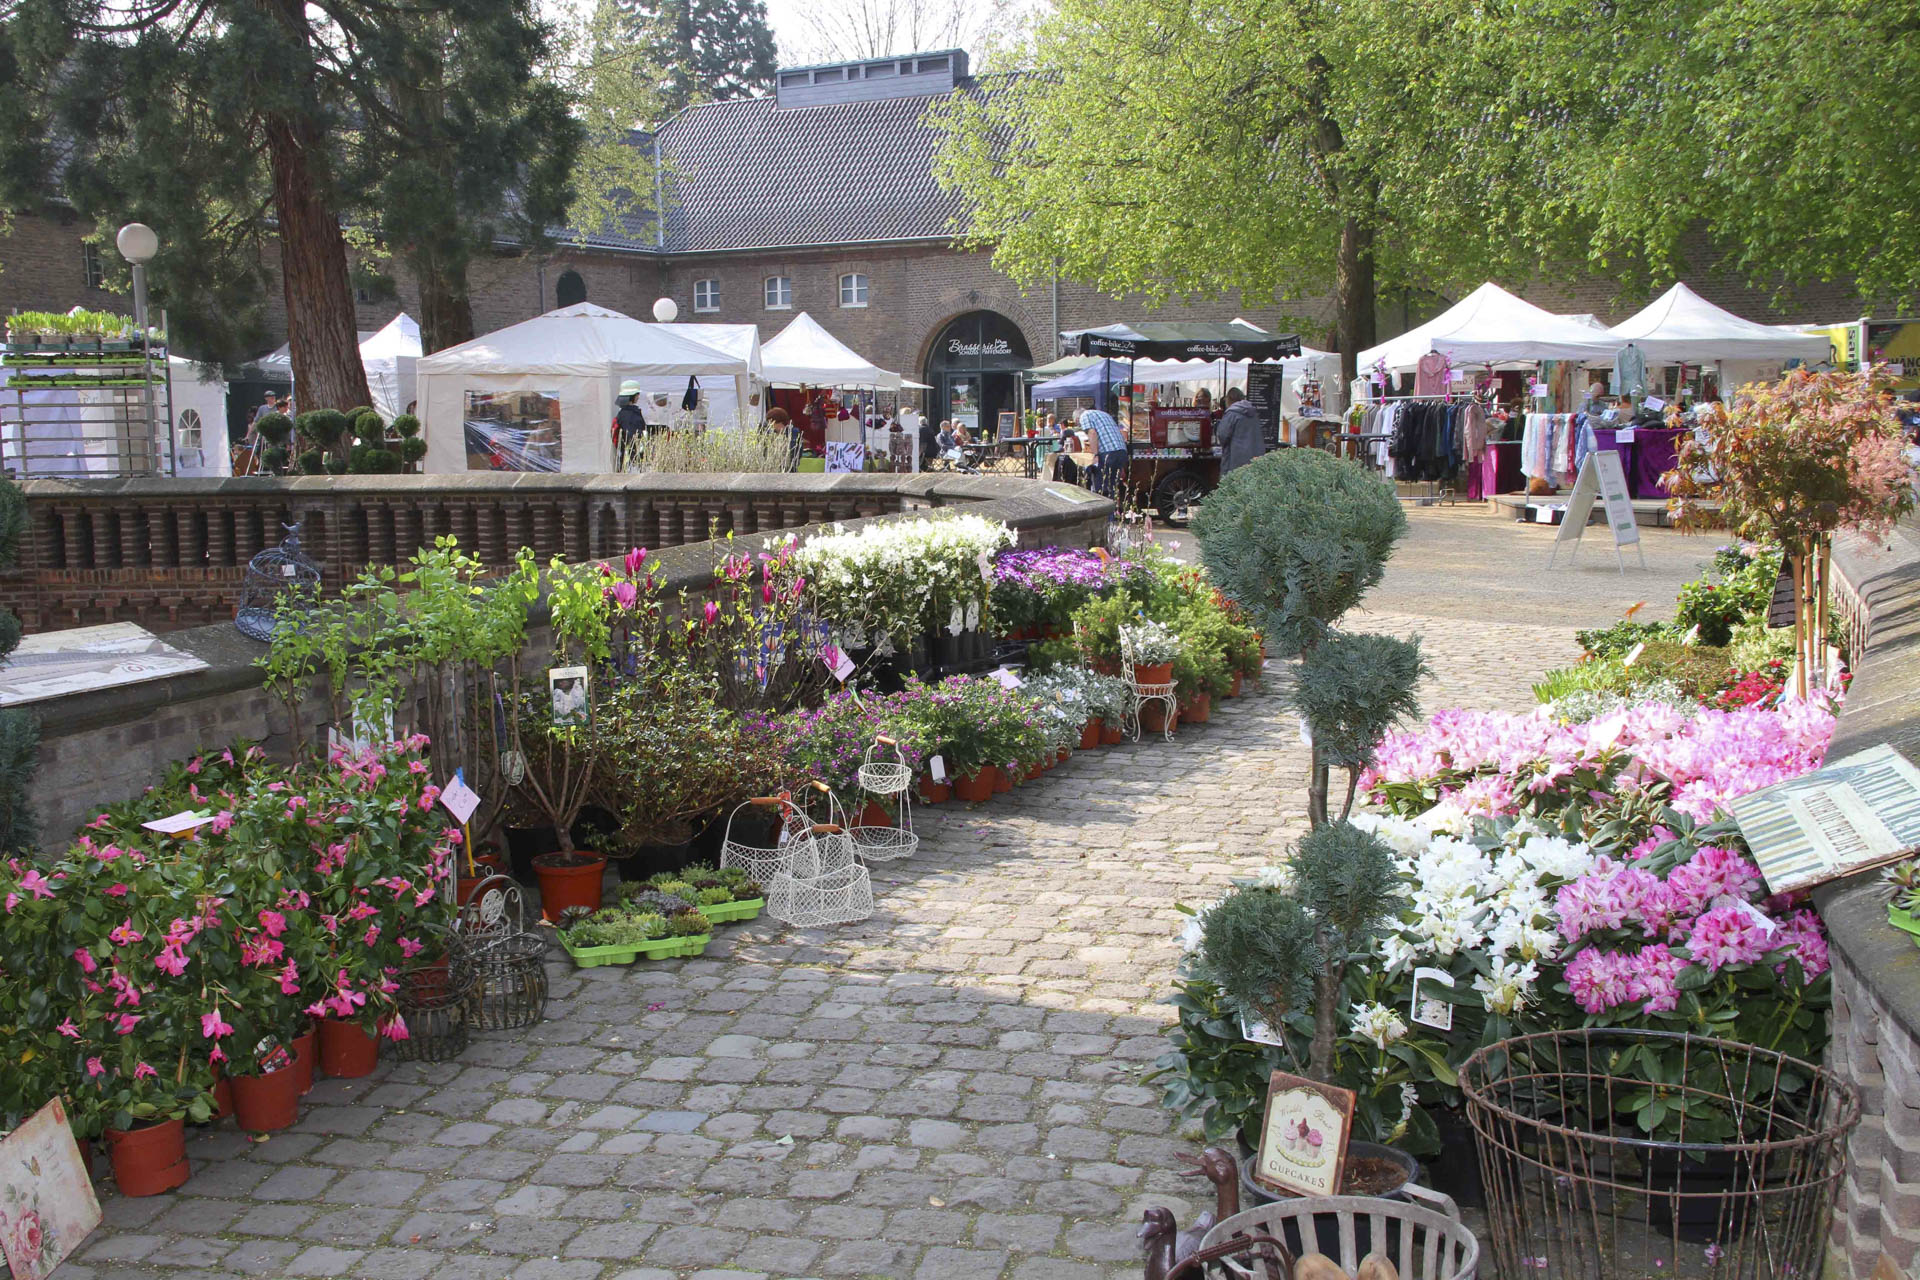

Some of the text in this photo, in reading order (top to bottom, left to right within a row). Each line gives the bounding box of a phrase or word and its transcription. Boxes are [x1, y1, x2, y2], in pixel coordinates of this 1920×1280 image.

[948, 338, 994, 353] Brasserie
[1848, 765, 1918, 808] BLUE
[1831, 832, 1869, 858] DAY
[1269, 1159, 1325, 1189] CUPCAKES
